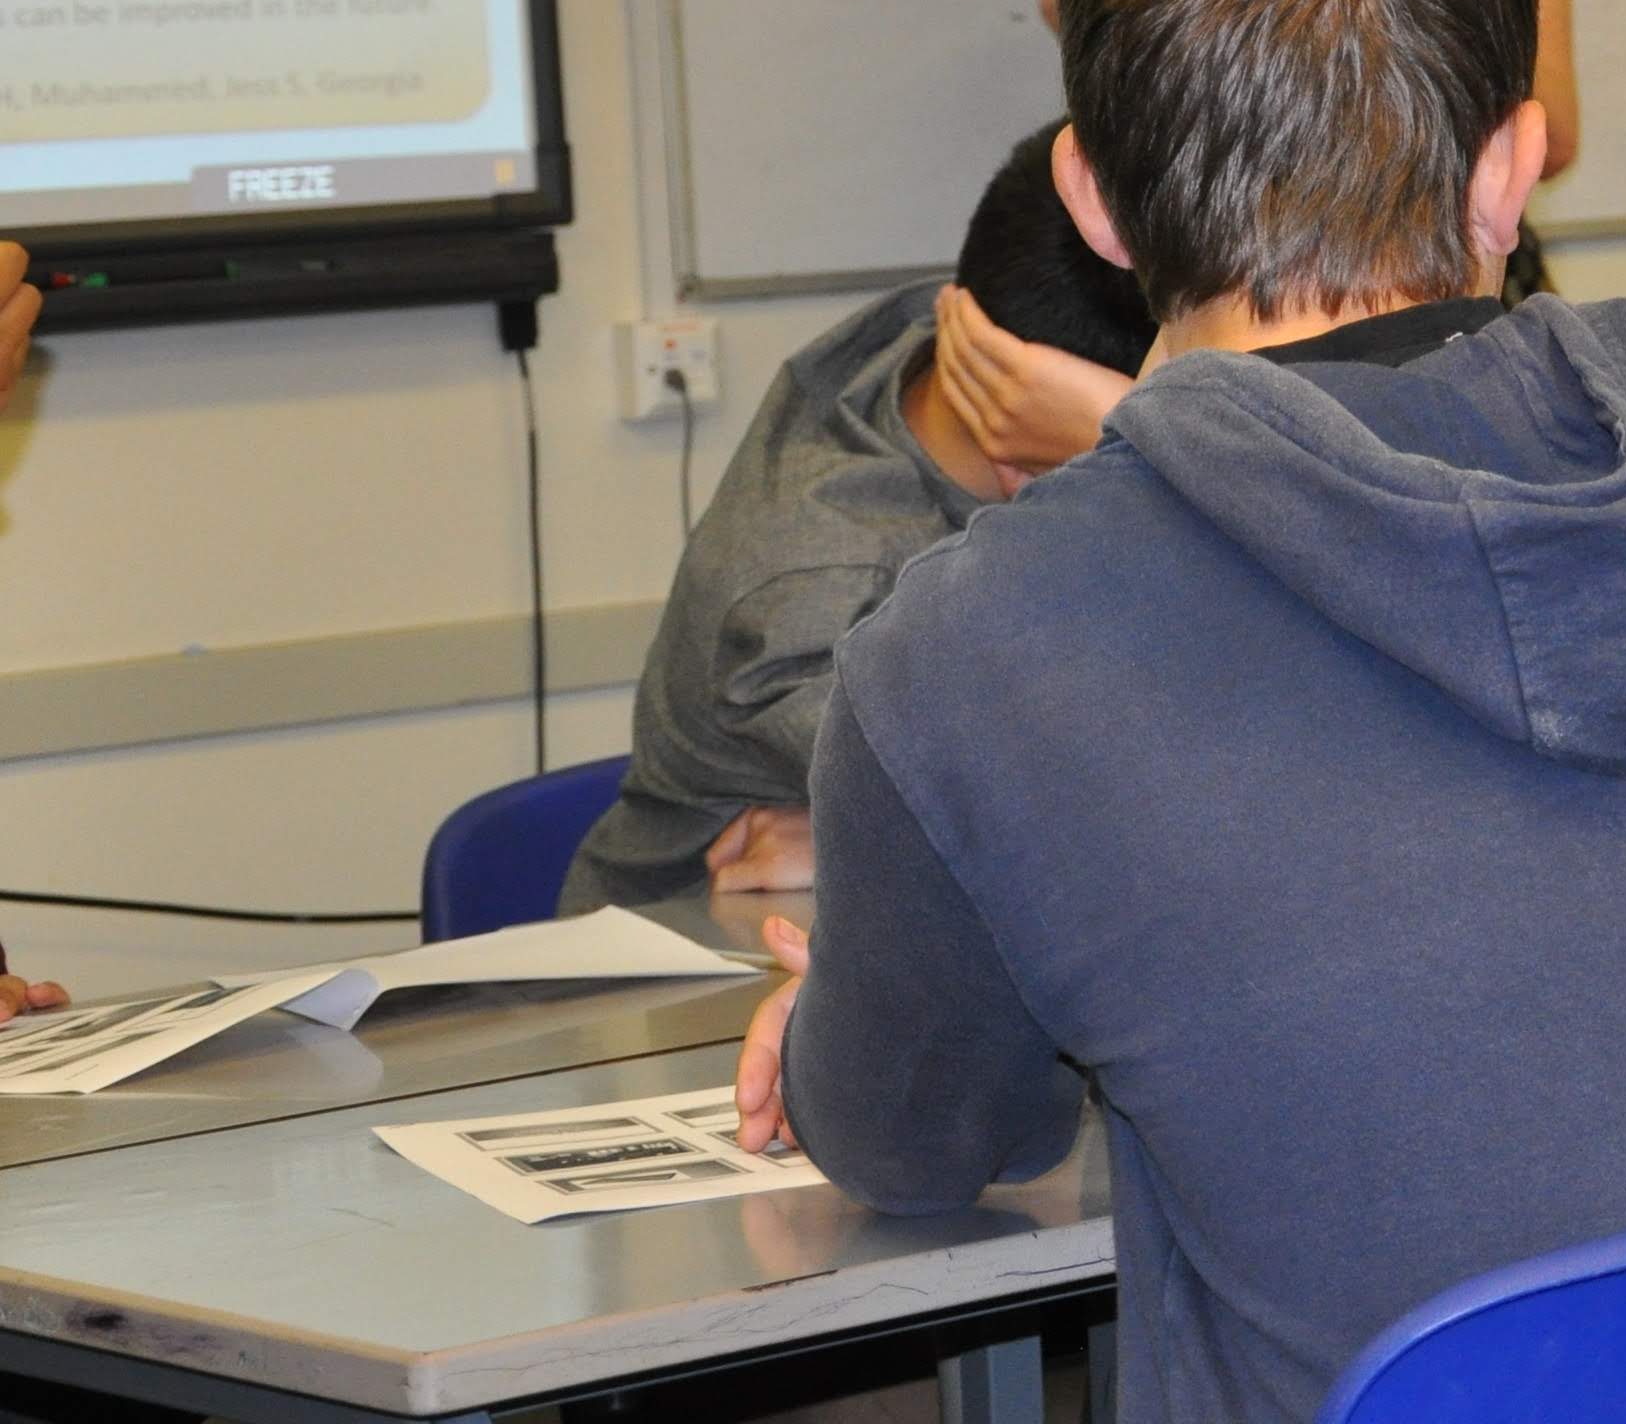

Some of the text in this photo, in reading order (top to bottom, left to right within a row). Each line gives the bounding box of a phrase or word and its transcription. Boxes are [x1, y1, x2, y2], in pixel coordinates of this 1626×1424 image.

[13, 5, 66, 29] can
[72, 0, 115, 26] be
[227, 165, 338, 205] FREEZE
